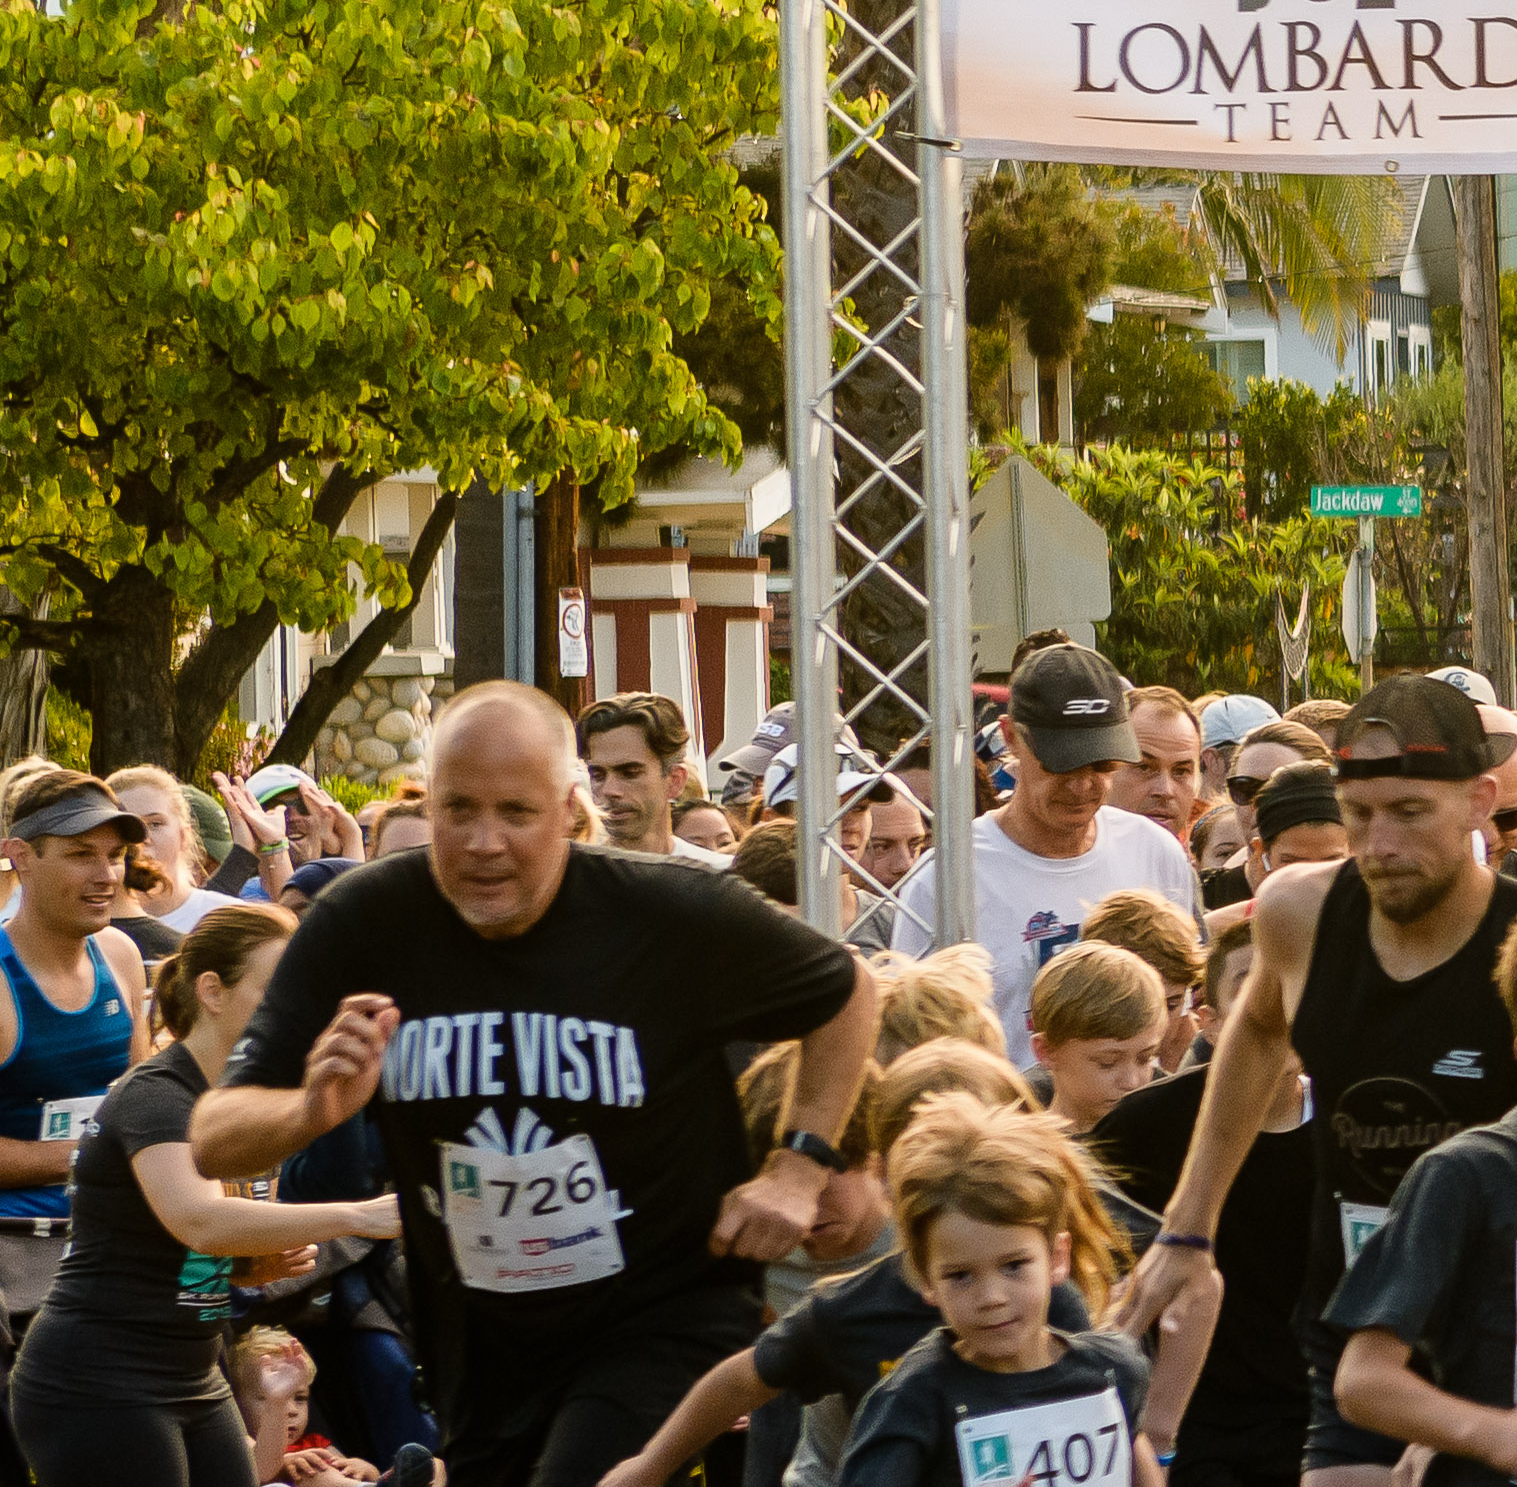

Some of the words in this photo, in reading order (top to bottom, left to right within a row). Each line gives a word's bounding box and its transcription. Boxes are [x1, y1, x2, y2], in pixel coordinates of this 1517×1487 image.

[1214, 98, 1424, 143] TEAM
[1316, 488, 1384, 511] Jackdaw
[511, 1011, 645, 1108] VISTA
[488, 1161, 596, 1217] 726
